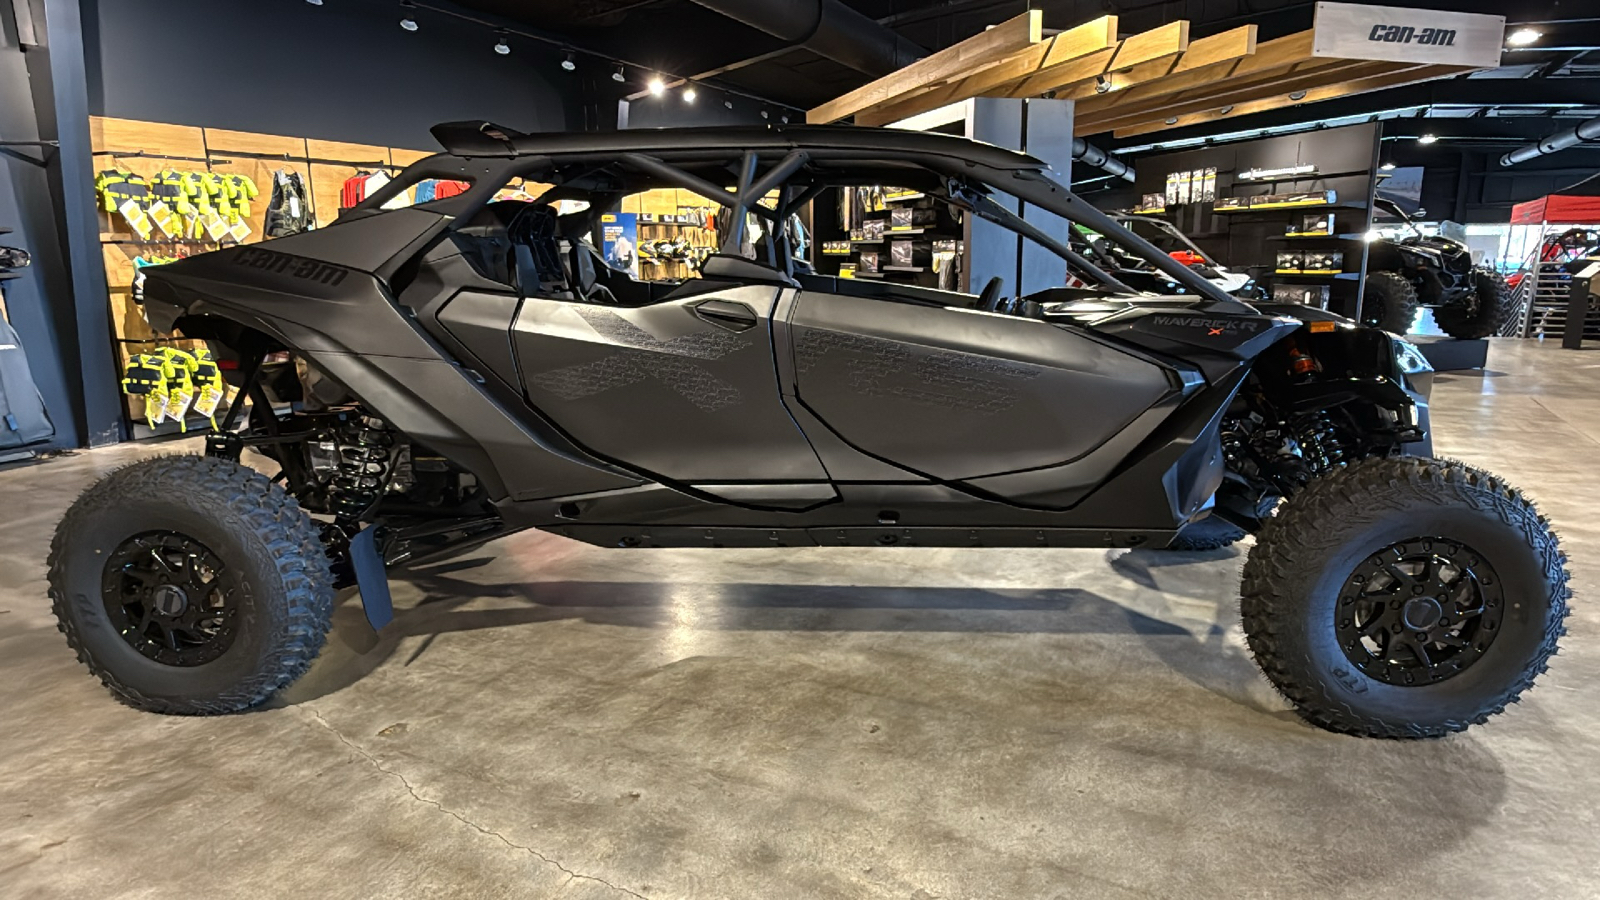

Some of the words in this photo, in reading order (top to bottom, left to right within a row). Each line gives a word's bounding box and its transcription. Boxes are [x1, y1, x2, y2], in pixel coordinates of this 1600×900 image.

[1368, 24, 1456, 46] can-am
[233, 245, 349, 287] can-am
[1153, 316, 1239, 329] MAVERICK
[1240, 321, 1258, 332] R
